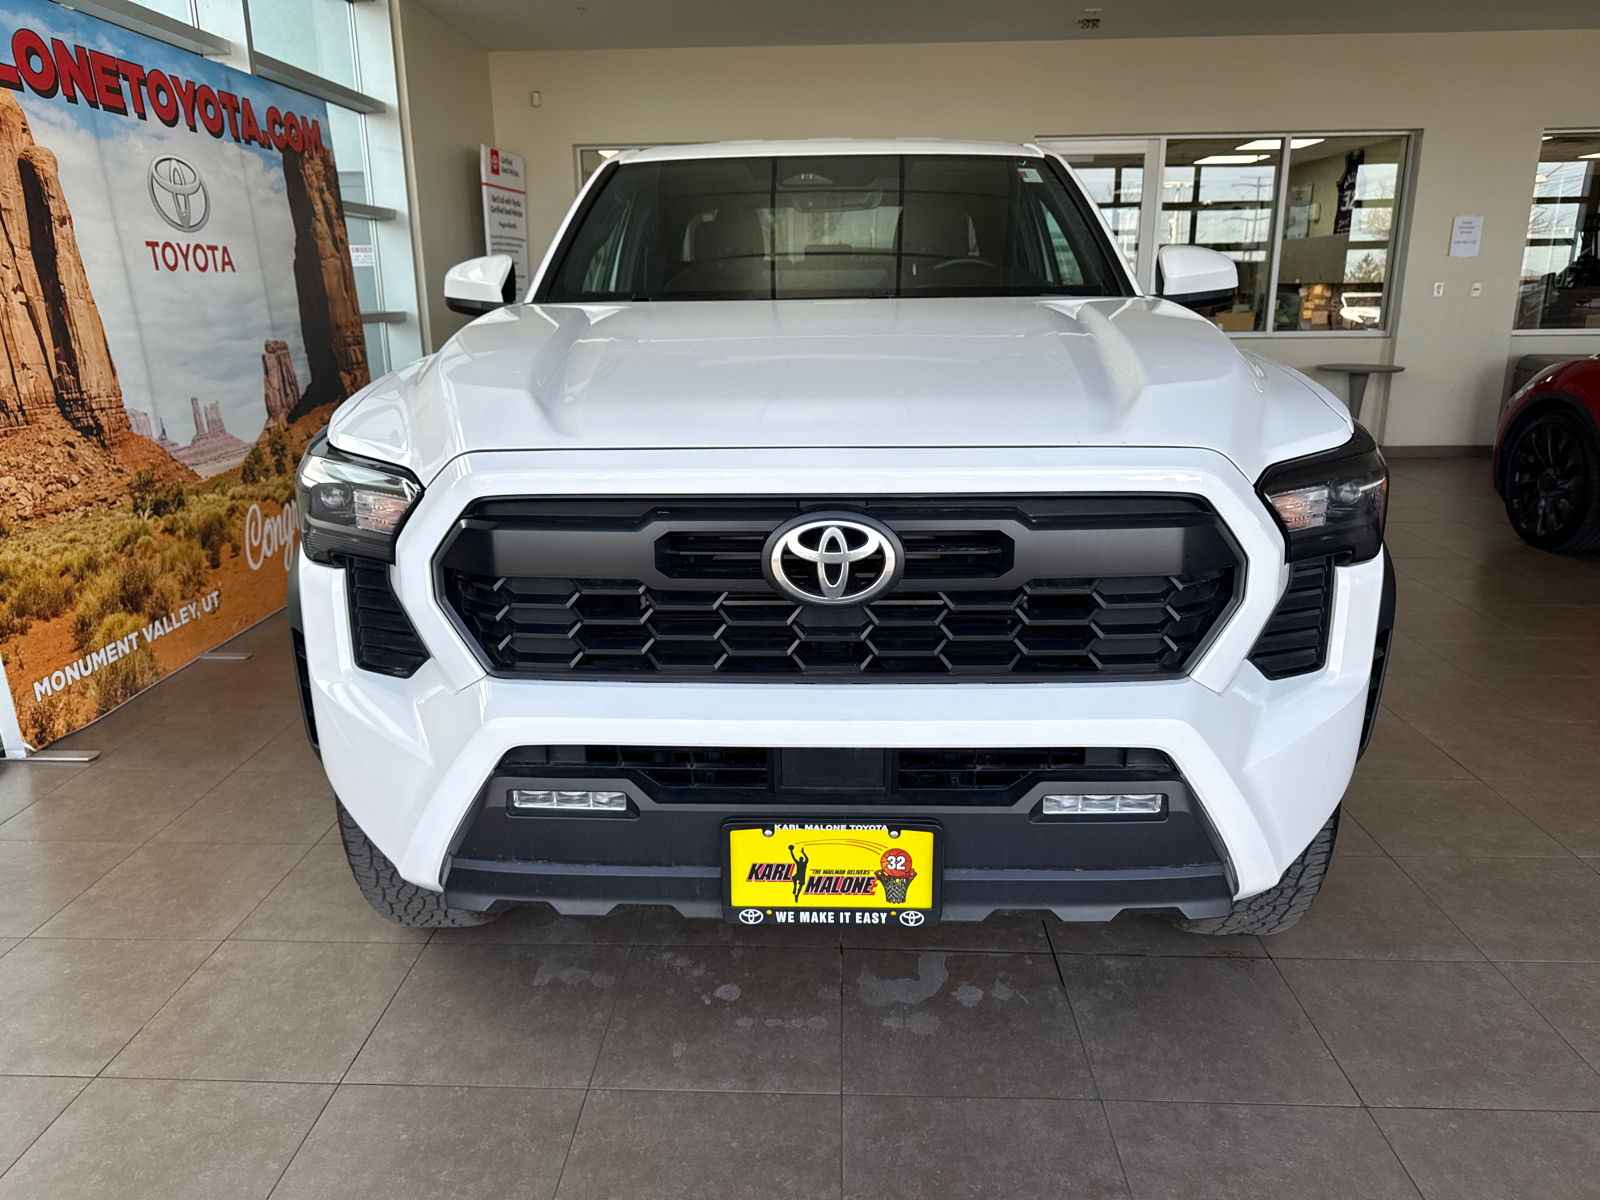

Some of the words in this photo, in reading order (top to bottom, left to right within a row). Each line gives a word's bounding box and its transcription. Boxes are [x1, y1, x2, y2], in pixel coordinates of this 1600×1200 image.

[145, 240, 237, 273] TOYOTA
[33, 631, 139, 701] MONUMENT
[141, 604, 201, 643] VALLEY,
[201, 590, 220, 613] UT
[746, 863, 795, 882] KARL
[887, 856, 906, 870] 32
[803, 876, 877, 895] MALONE
[776, 911, 794, 923] WE
[800, 911, 835, 924] MAKE
[840, 912, 850, 924] IT
[856, 912, 888, 924] EASY
